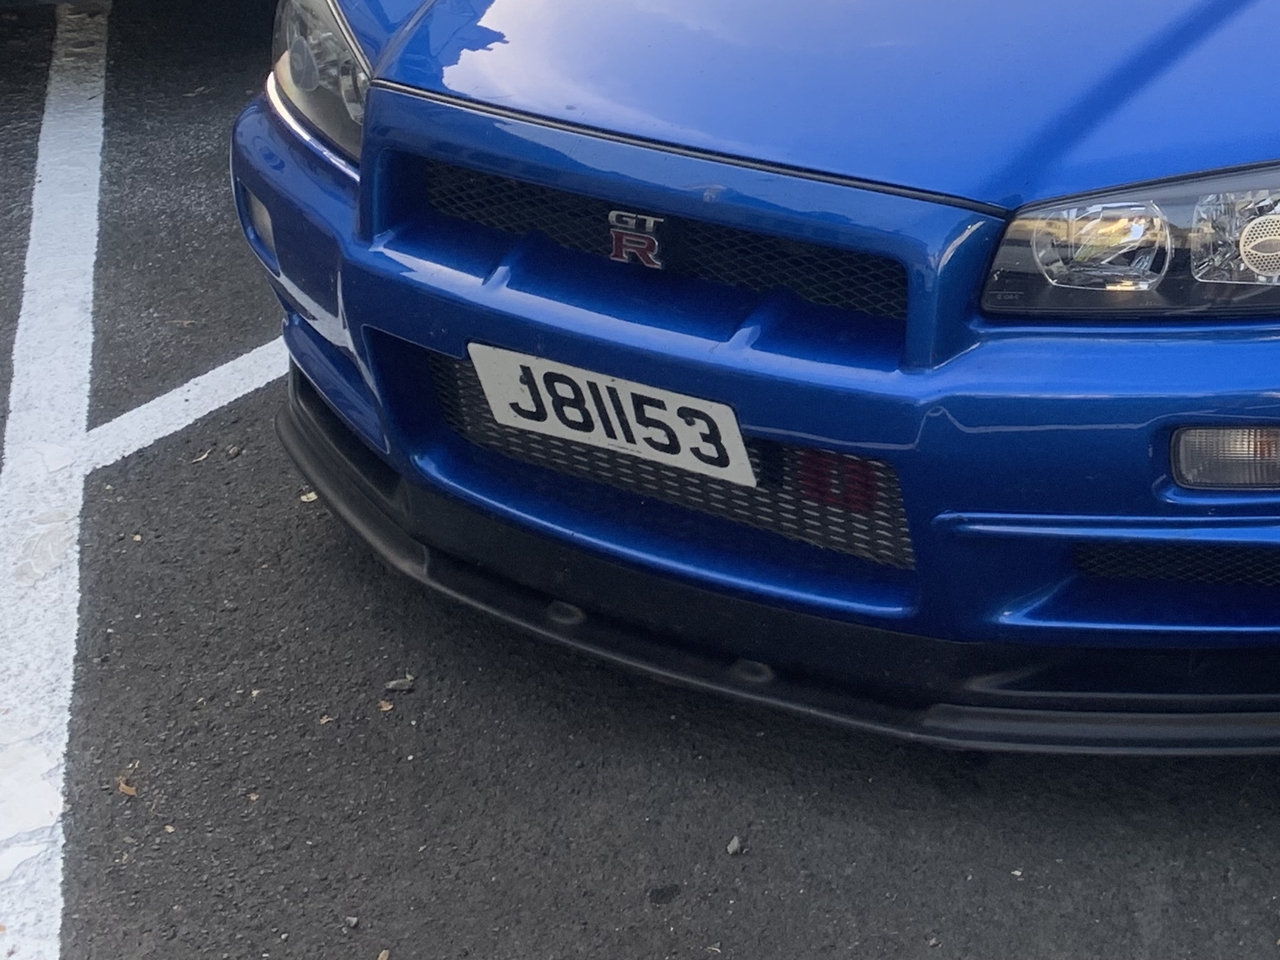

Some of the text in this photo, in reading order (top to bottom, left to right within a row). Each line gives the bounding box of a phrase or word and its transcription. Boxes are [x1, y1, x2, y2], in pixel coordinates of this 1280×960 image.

[608, 210, 664, 232] GT
[610, 228, 662, 269] R
[509, 365, 730, 468] J81153
